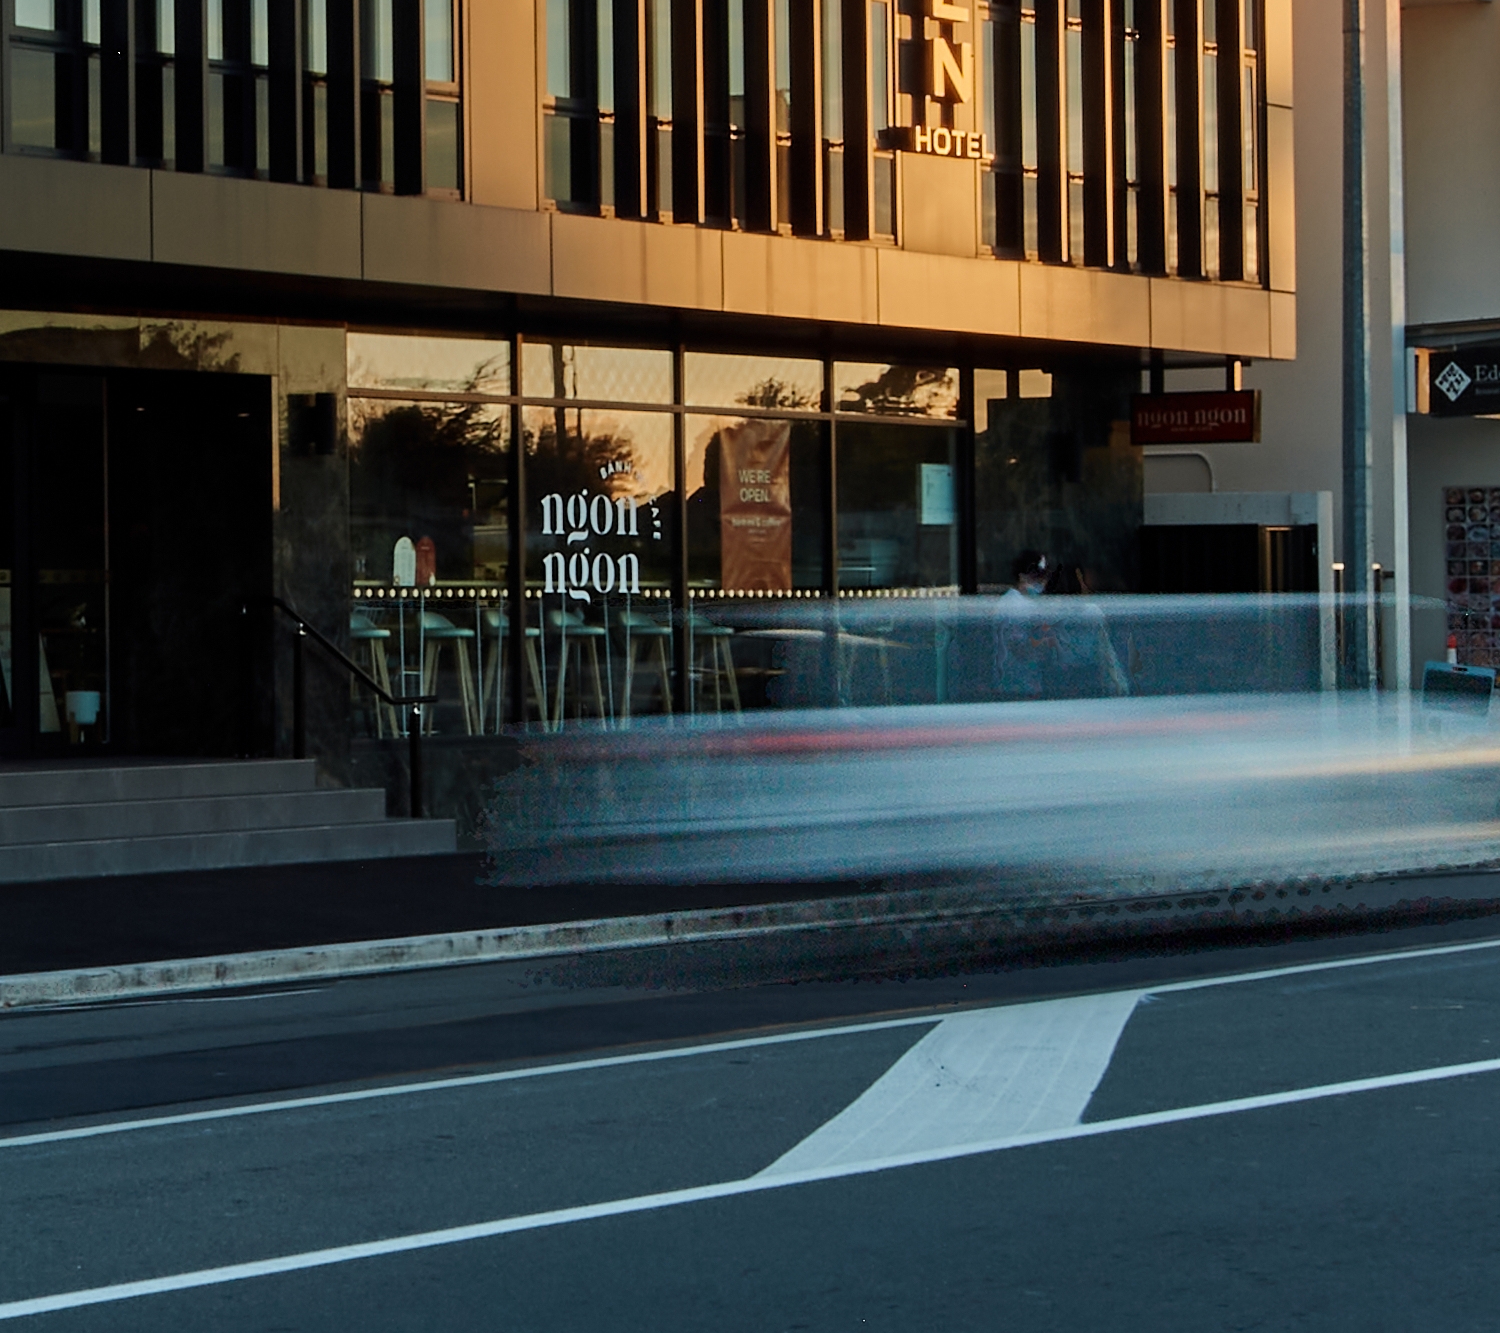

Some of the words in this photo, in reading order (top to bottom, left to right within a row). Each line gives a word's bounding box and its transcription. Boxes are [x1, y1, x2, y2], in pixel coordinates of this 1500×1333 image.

[915, 125, 996, 161] HOTEL
[1137, 409, 1189, 428] ngon
[1195, 406, 1246, 426] ngon
[540, 488, 639, 546] ngon
[542, 546, 641, 605] ngon
